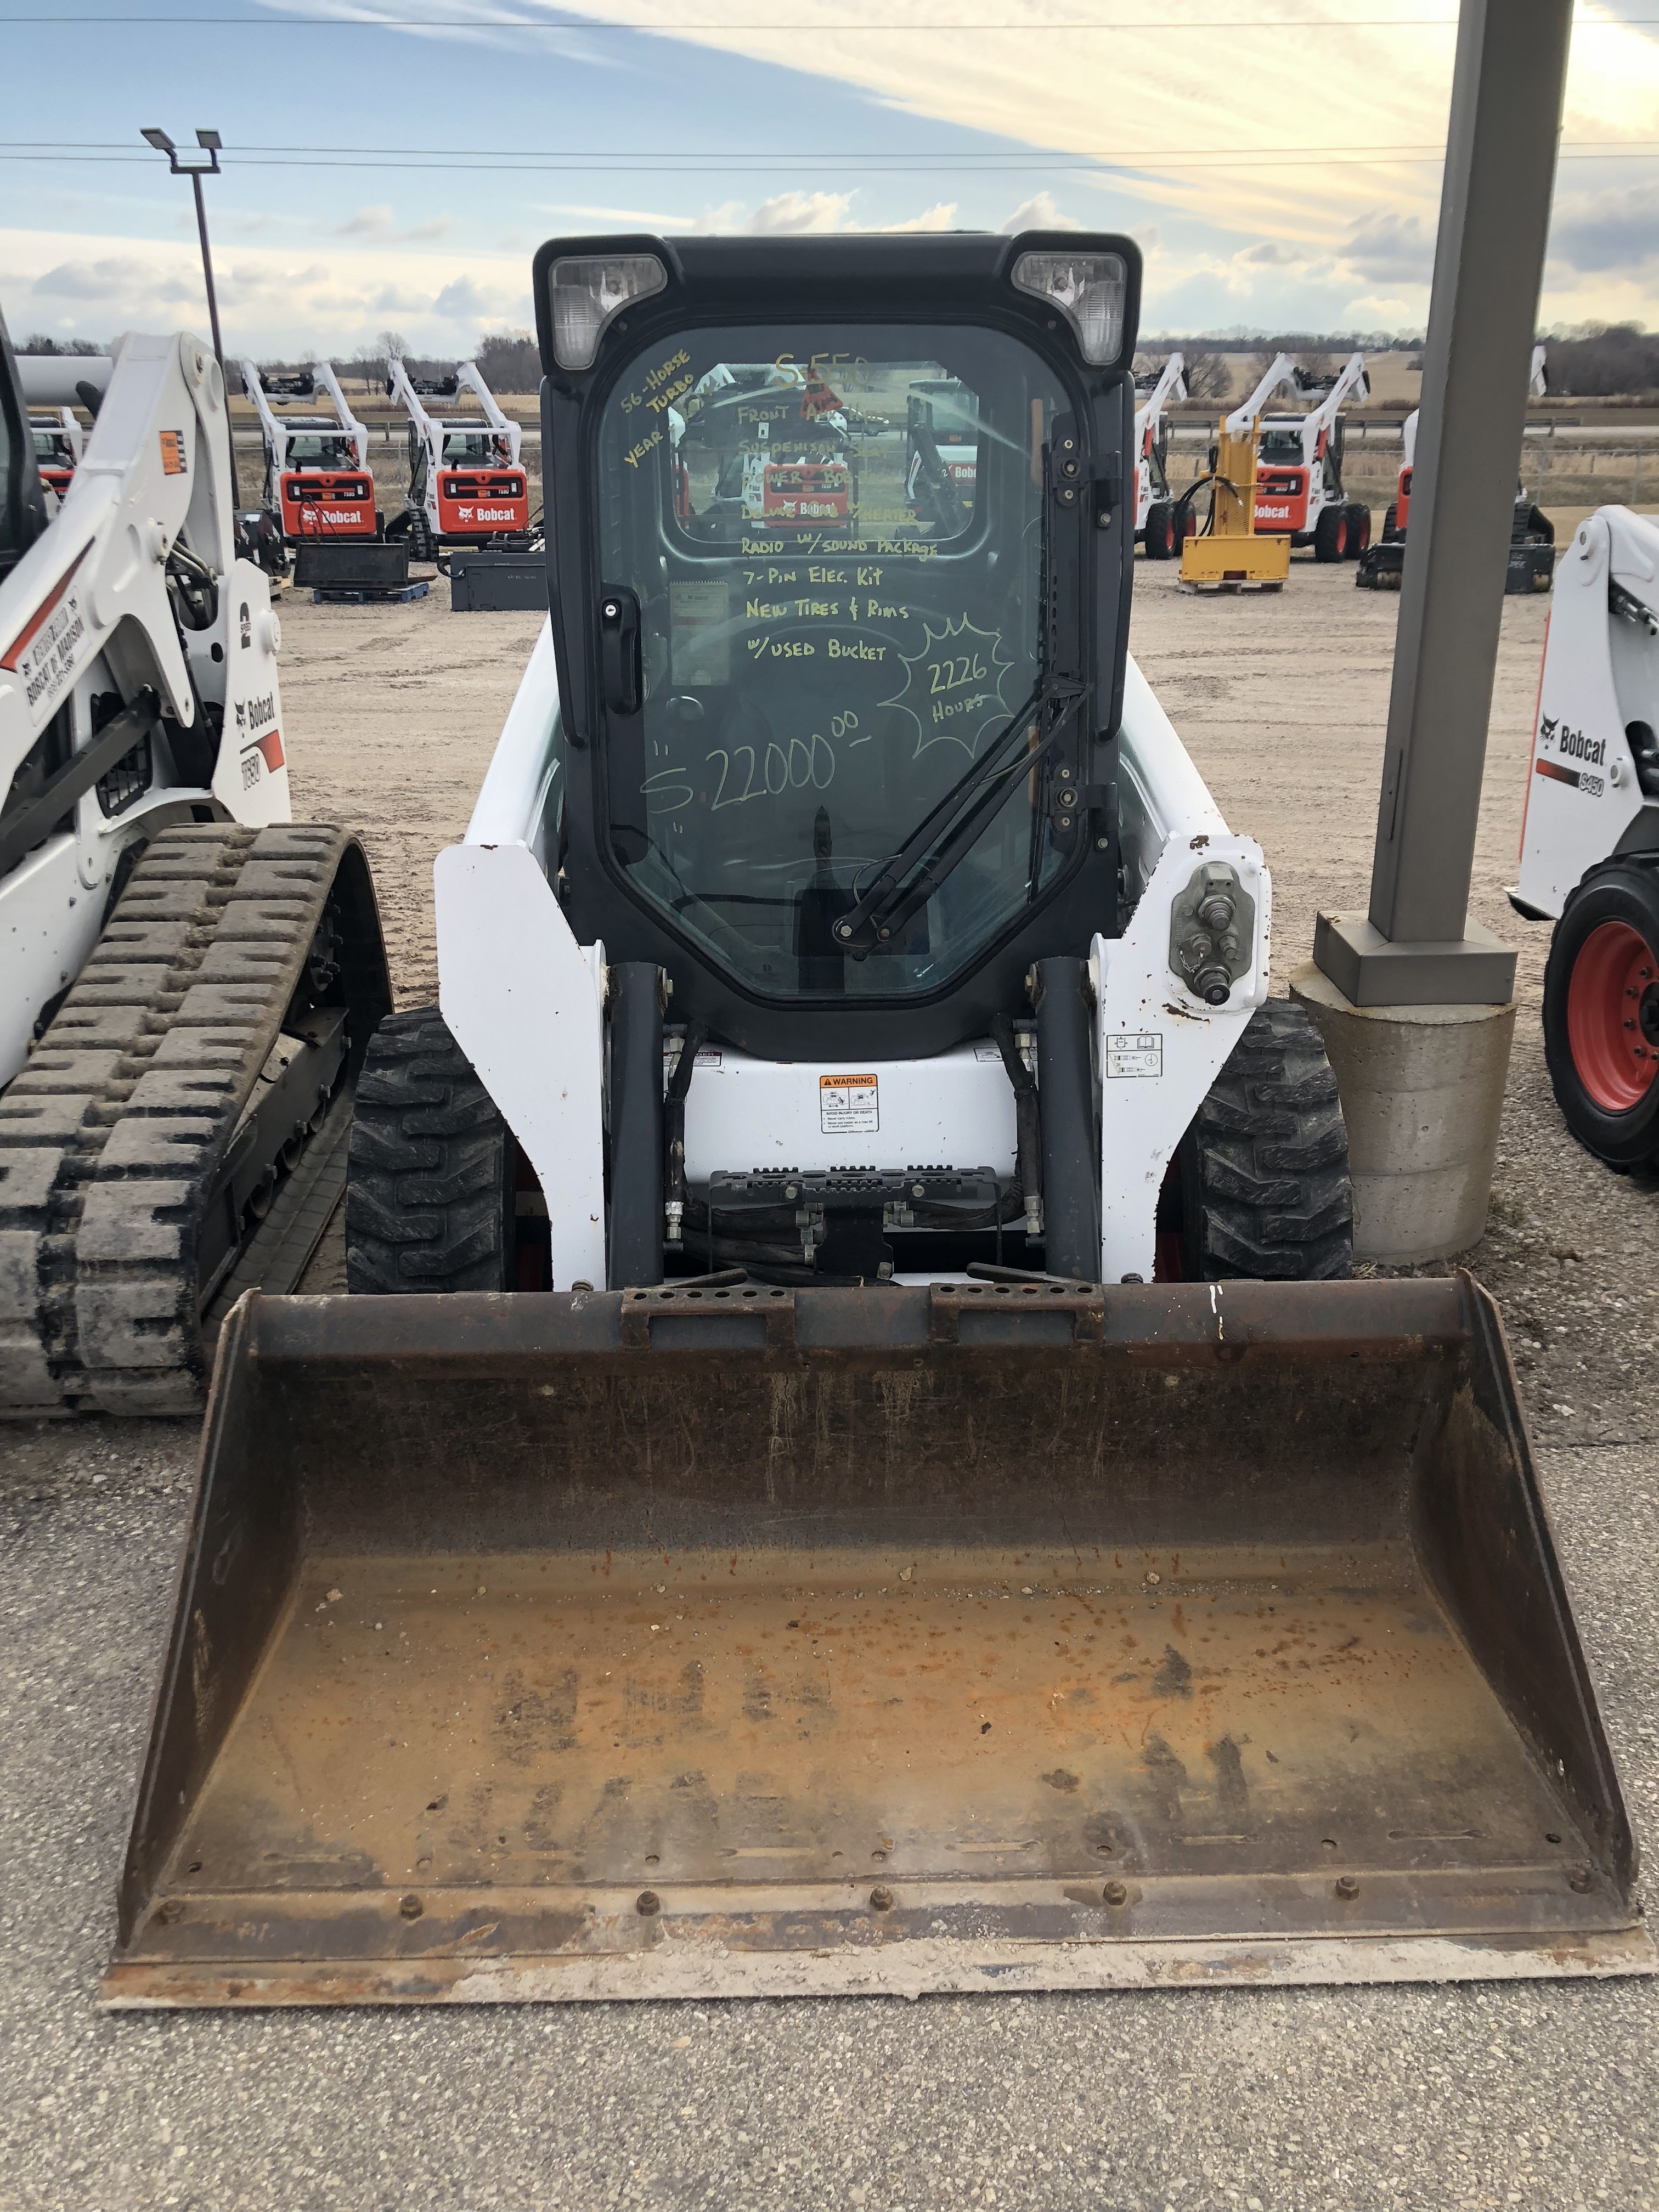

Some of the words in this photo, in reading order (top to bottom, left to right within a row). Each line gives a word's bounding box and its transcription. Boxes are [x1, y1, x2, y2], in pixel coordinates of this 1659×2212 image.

[774, 352, 873, 386] S-550
[646, 374, 694, 413] TURBO
[738, 405, 790, 425] FRONT
[741, 470, 803, 490] POWER
[322, 510, 362, 524] Bobcat
[477, 507, 515, 521] Bobcat
[1254, 504, 1290, 518] Bobcat
[742, 537, 785, 555] RADIO
[746, 598, 787, 618] NEW
[795, 598, 839, 617] TIRES
[828, 639, 887, 661] BUCKET
[927, 653, 987, 694] 2226
[248, 691, 275, 730] Bobcat
[932, 693, 983, 723] HOURS
[1560, 725, 1606, 766] Bobcat
[1580, 772, 1605, 797] S450
[833, 1077, 873, 1085] WARNING
